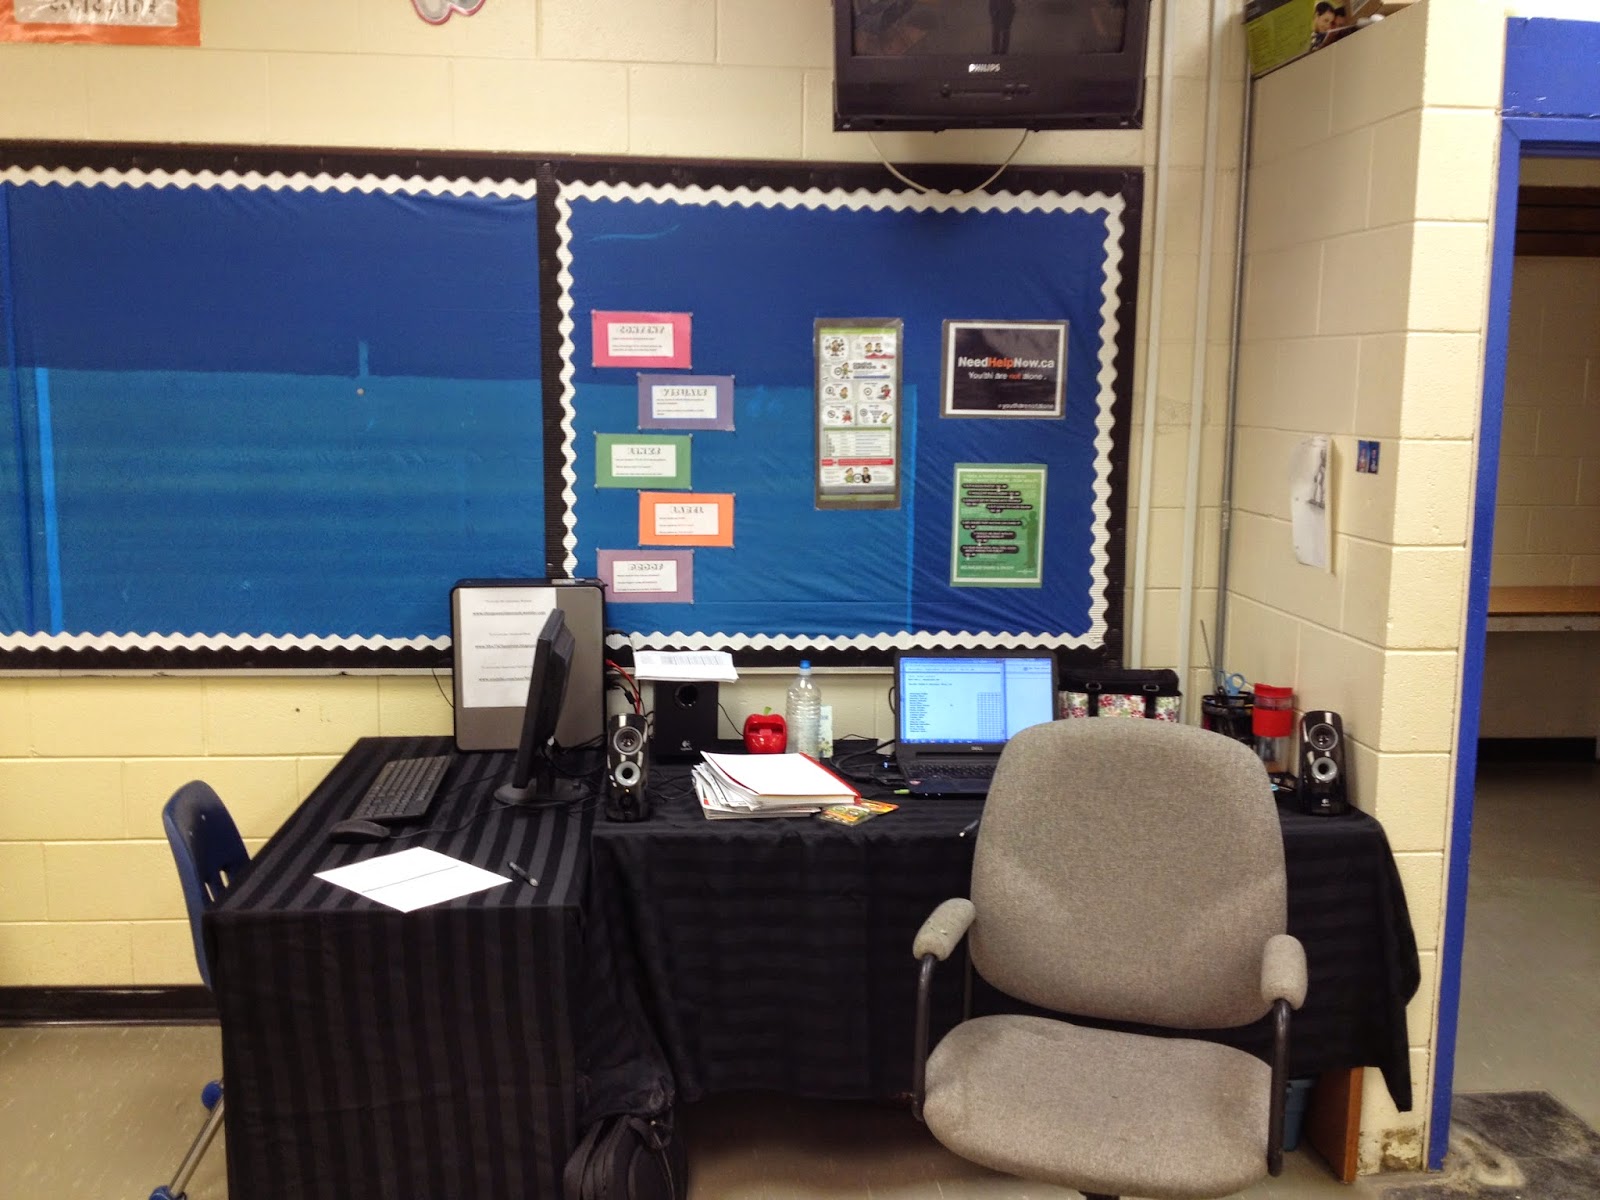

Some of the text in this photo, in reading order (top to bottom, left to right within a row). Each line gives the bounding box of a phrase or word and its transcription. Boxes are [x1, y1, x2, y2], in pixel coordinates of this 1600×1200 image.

[968, 63, 1000, 73] PHILIPS
[957, 356, 1055, 369] NeedHelpNow.ca
[994, 372, 1008, 380] are
